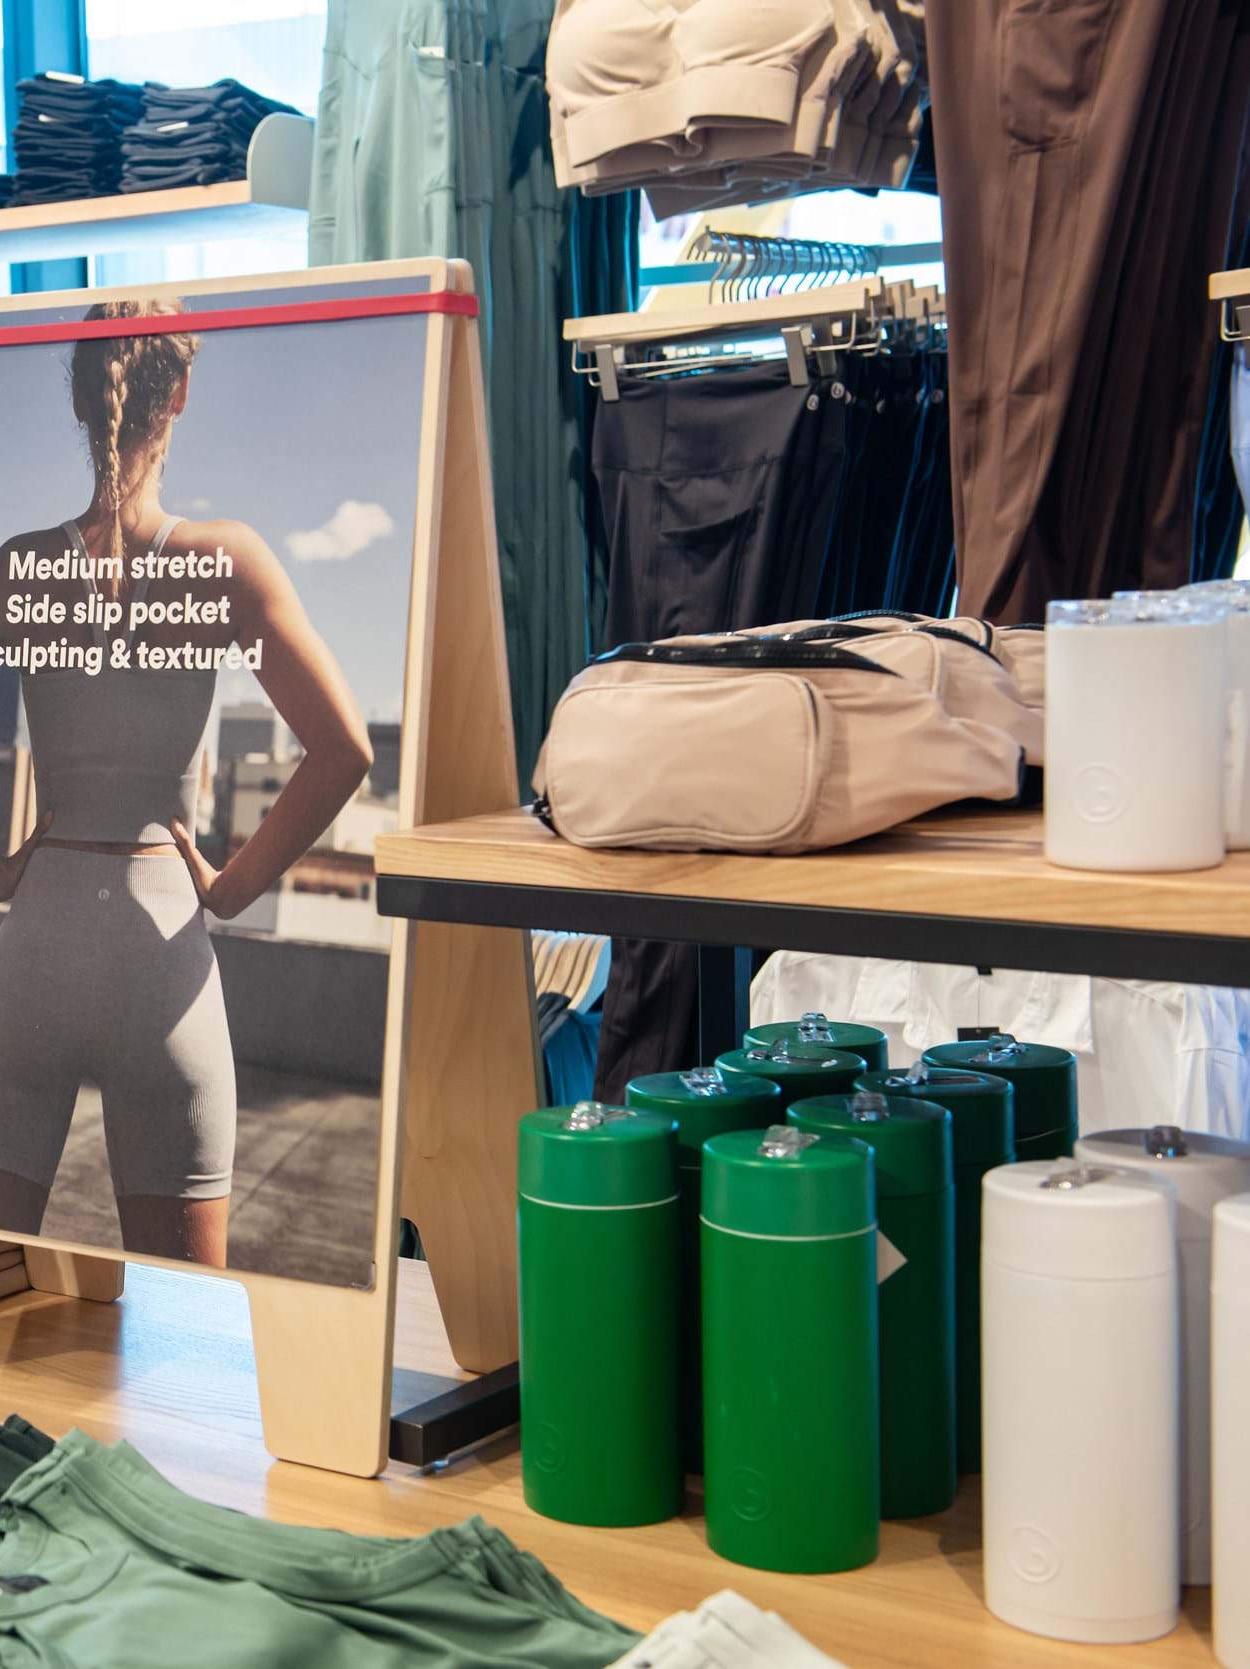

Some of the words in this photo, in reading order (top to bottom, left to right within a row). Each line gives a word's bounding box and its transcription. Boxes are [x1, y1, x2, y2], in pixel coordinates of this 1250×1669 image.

[8, 549, 123, 580] Medium
[131, 547, 233, 578] stretch
[5, 594, 67, 624] Side
[72, 593, 123, 631] slip
[130, 593, 231, 631] pocket
[110, 638, 131, 669] &
[137, 639, 263, 670] textured
